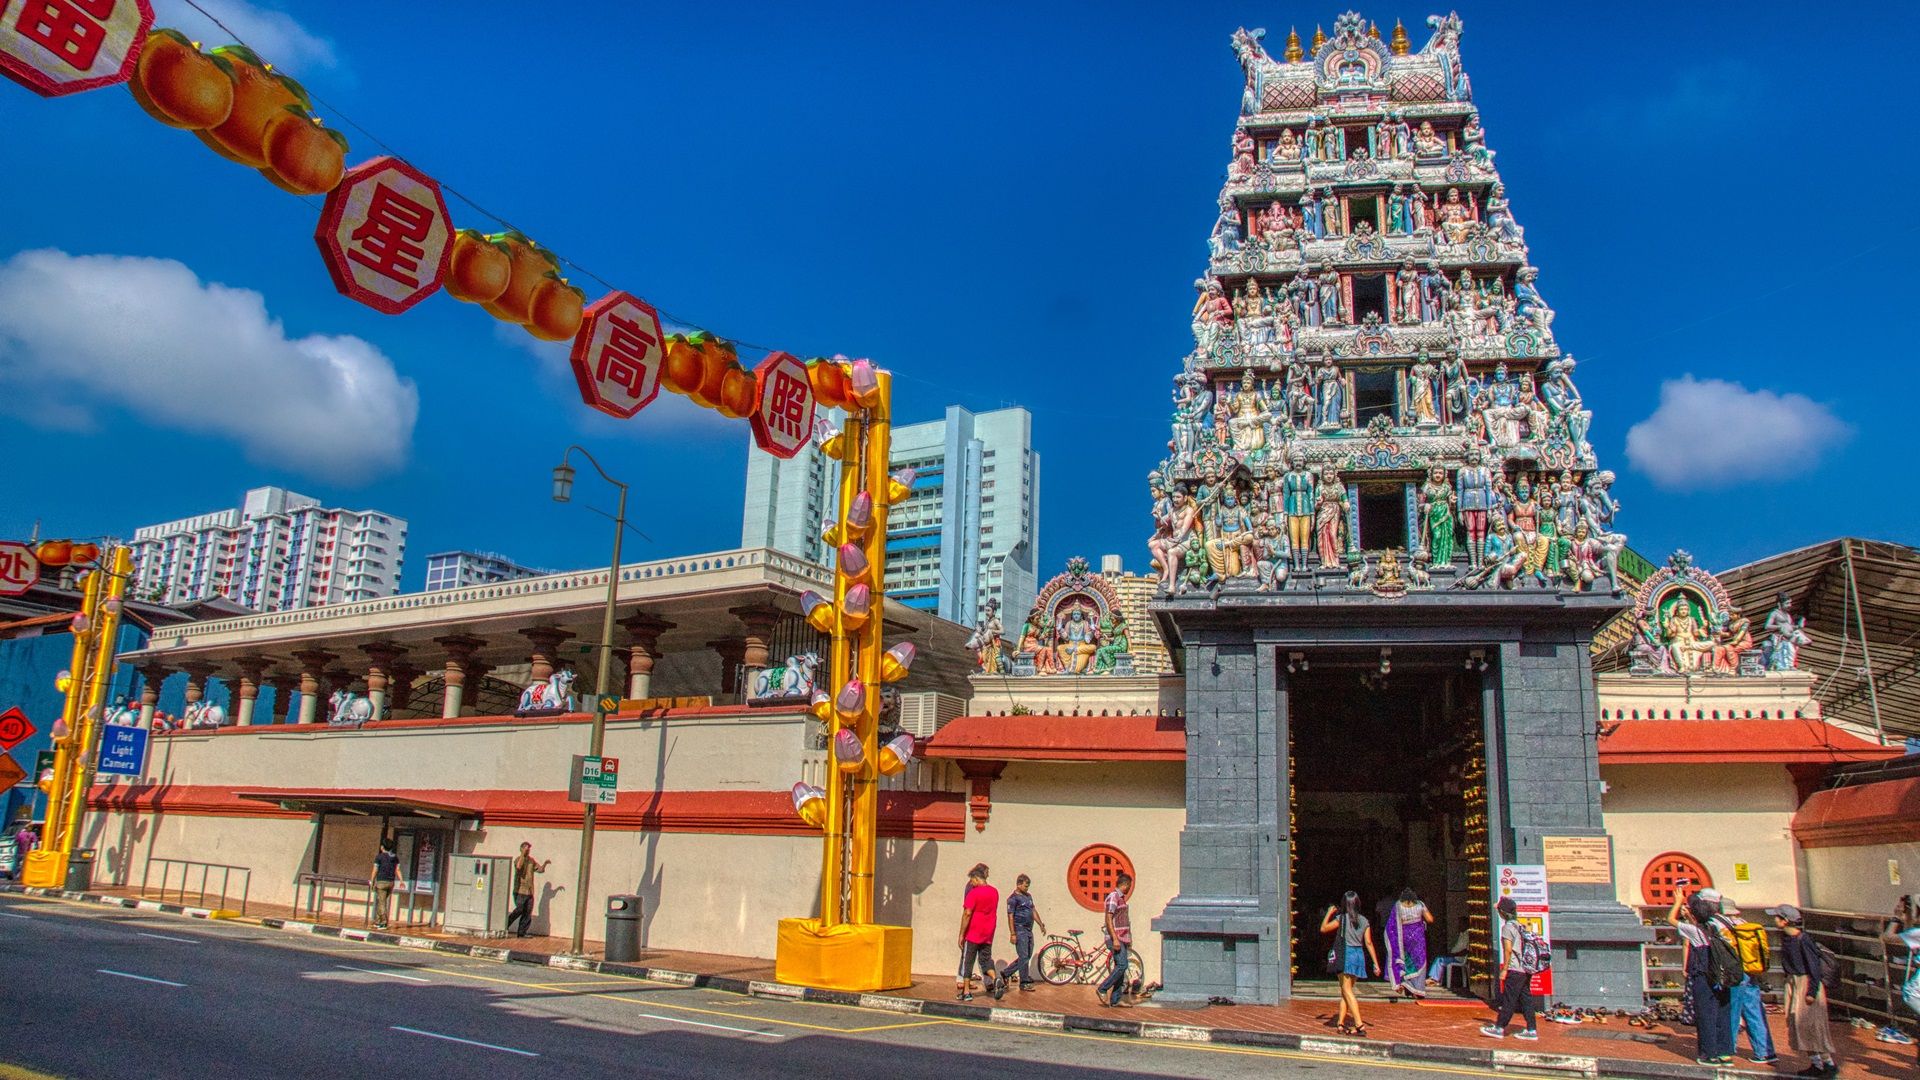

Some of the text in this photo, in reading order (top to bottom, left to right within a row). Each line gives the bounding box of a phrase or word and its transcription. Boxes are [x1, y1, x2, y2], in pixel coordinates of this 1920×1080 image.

[347, 182, 807, 441] 星 高 照
[3, 722, 19, 735] 40
[117, 731, 134, 742] Red
[111, 745, 134, 756] Light
[102, 758, 135, 770] Camera
[584, 767, 599, 776] D16
[599, 791, 606, 801] 4
